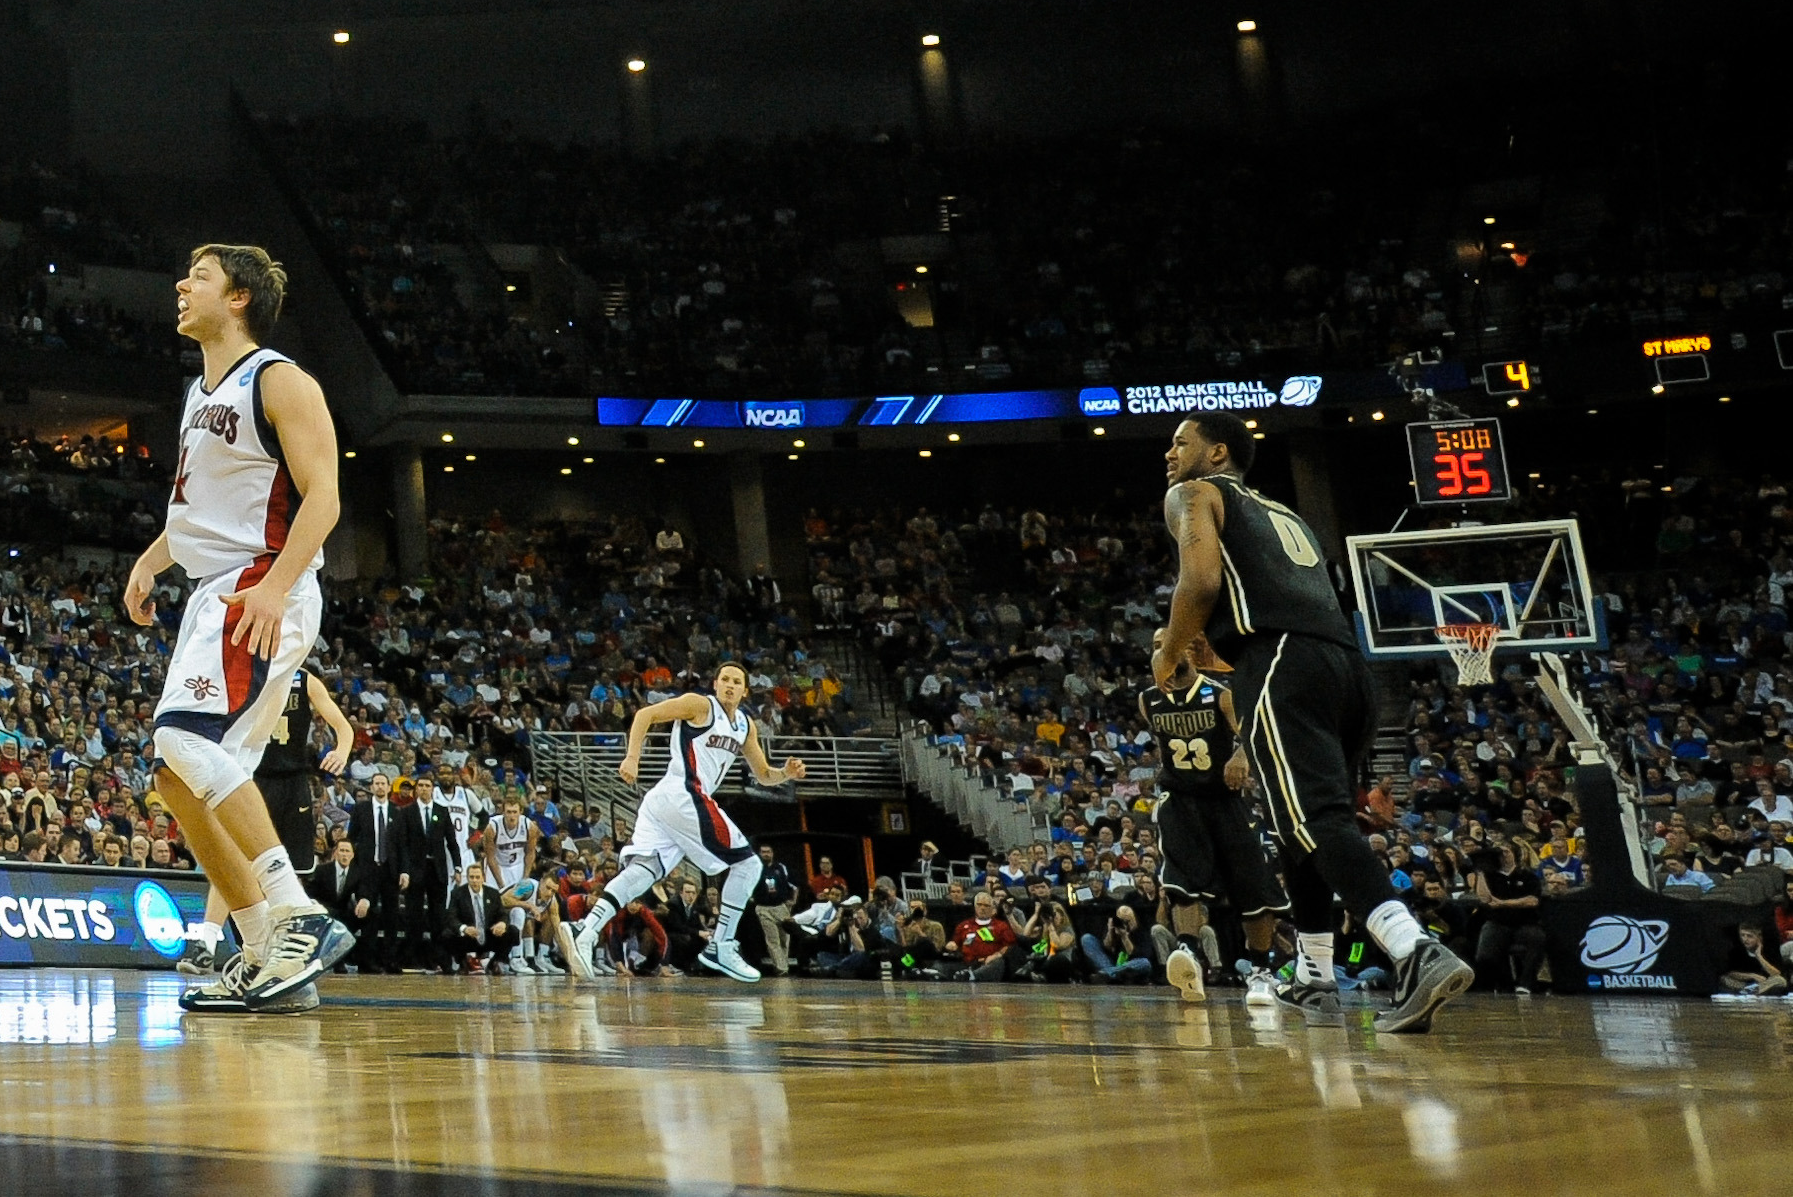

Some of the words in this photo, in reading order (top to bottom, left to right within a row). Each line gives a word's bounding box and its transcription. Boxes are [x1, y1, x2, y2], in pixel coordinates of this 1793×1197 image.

[1643, 341, 1662, 356] ST
[1506, 362, 1530, 390] 4
[1126, 385, 1162, 399] 2012
[1164, 381, 1268, 397] BASKETBALL
[1084, 400, 1120, 411] NCAA
[1128, 392, 1277, 414] CHAMPIONSHIP
[745, 409, 801, 427] NCAA
[1436, 429, 1491, 451] 5:08
[1434, 453, 1491, 496] 35
[1152, 709, 1216, 737] PURDUE
[1168, 738, 1212, 770] 23
[1603, 974, 1677, 989] BASKETBALL
